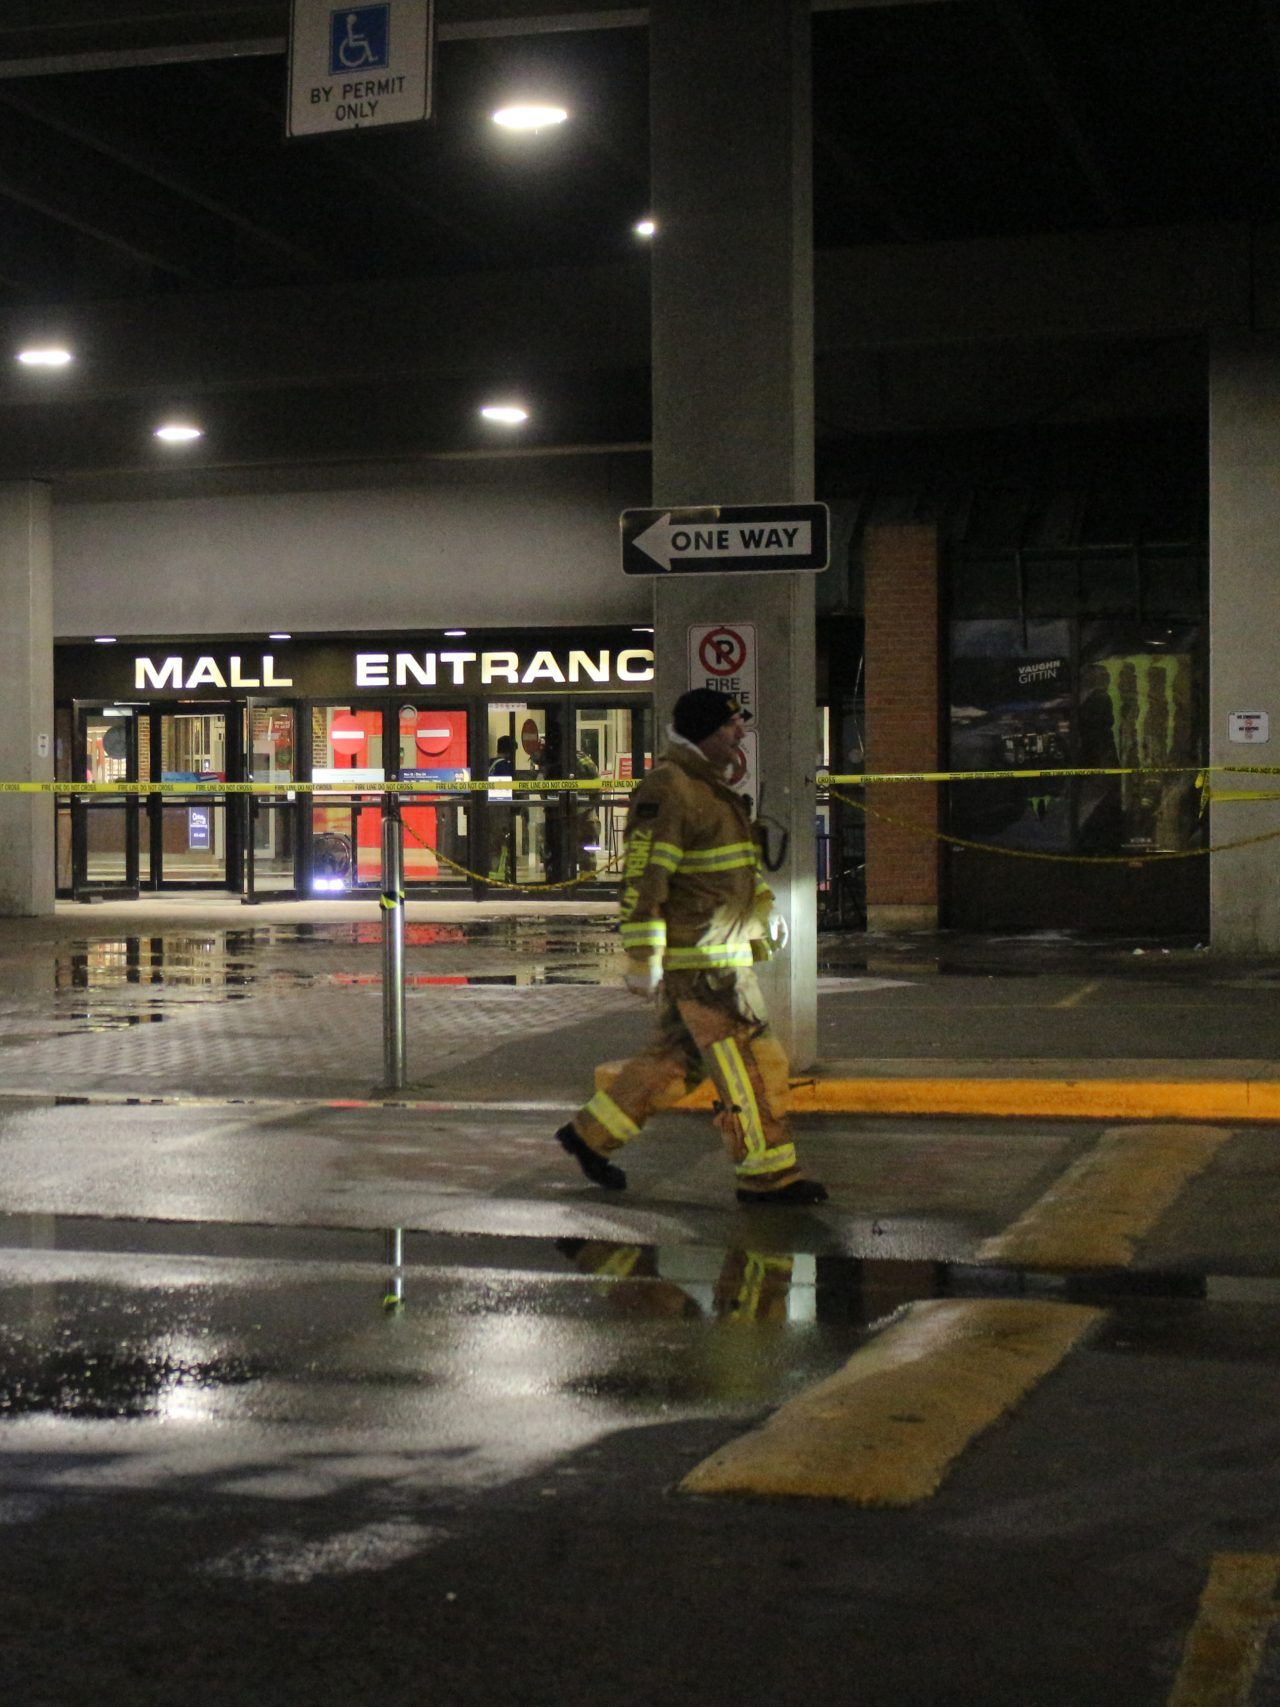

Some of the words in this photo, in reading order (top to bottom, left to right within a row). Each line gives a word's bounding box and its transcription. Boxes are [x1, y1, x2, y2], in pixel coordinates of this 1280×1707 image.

[310, 86, 333, 104] BY
[342, 76, 406, 100] PERMIT
[335, 100, 379, 121] ONLY
[671, 530, 730, 551] ONE
[739, 527, 799, 549] WAY
[135, 655, 293, 689] MALL
[356, 649, 655, 686] ENTRANC
[705, 678, 740, 692] FIRE
